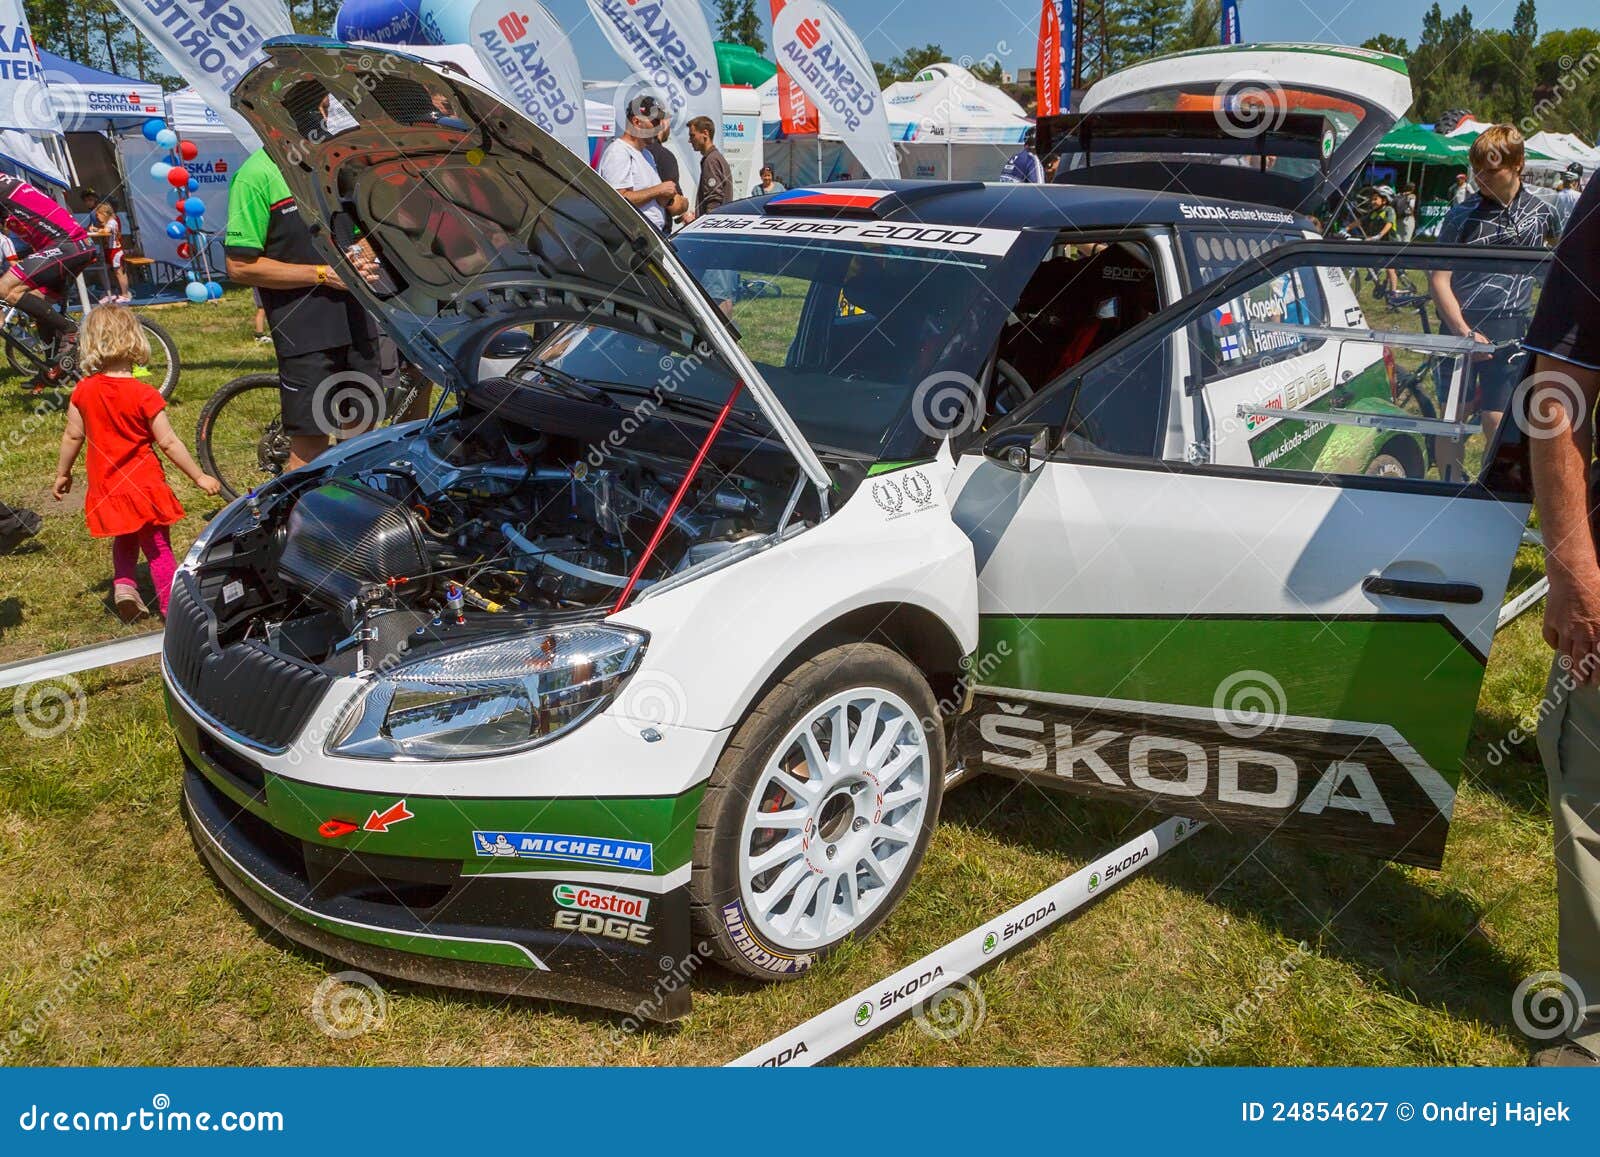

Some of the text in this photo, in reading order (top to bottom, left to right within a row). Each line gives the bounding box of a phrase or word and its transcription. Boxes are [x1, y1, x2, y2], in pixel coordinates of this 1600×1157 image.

[88, 91, 128, 104] ČESKÁ
[1180, 203, 1295, 225] ŠKODA Genuine Accessories
[693, 218, 982, 246] Fabia Super 2000
[1243, 294, 1288, 320] Kopecký
[1283, 363, 1332, 410] EDGE
[979, 701, 1396, 825] ŠKODA
[521, 837, 644, 862] MICHELIN
[1104, 847, 1149, 881] ŠKODA
[577, 889, 643, 917] Castrol
[553, 910, 655, 945] EDGE
[1002, 901, 1057, 941] ŠKODA
[723, 906, 794, 973] MICHELIN
[879, 965, 945, 1012] ŠKODA
